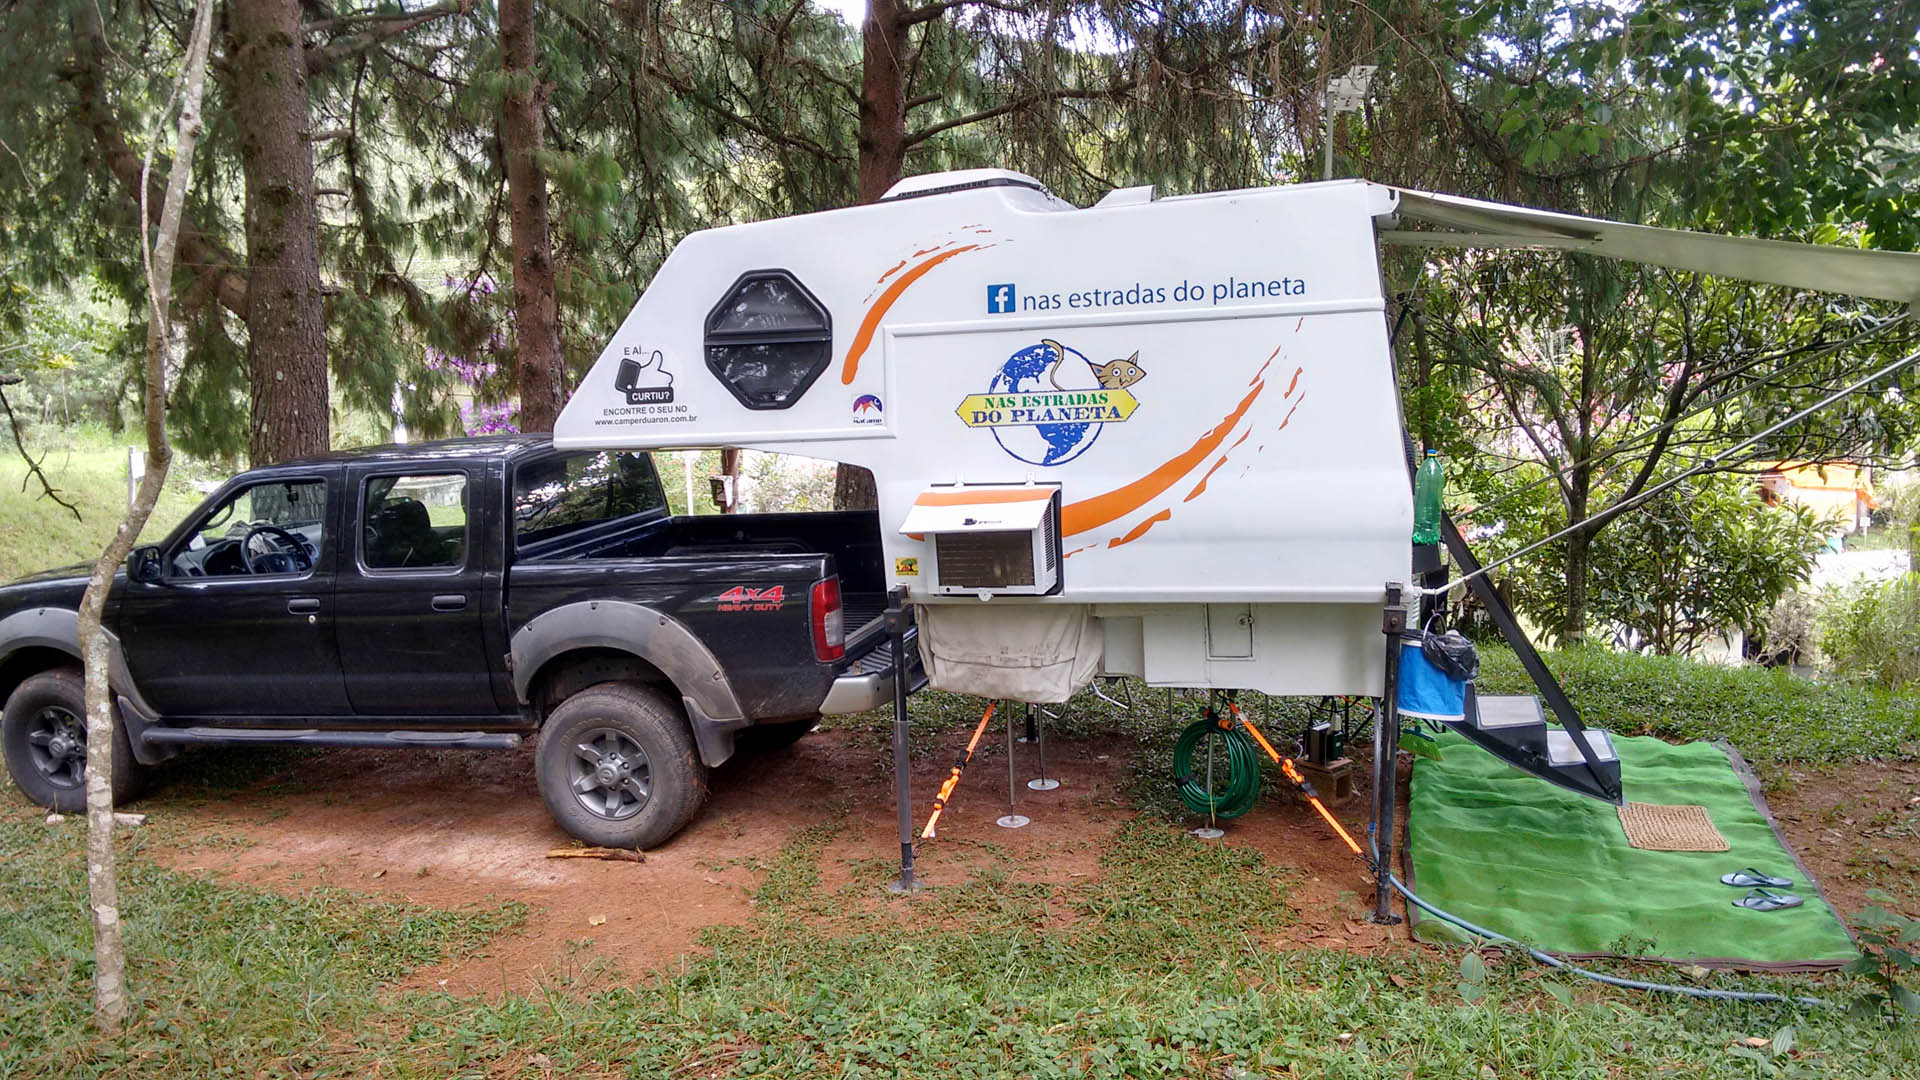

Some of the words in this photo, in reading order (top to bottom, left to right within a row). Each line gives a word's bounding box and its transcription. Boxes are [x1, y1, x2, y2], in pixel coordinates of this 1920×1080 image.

[1023, 294, 1061, 311] nas
[1068, 283, 1166, 308] estradas
[1173, 280, 1205, 302] do
[1213, 276, 1305, 304] planeta
[624, 347, 630, 355] E
[631, 391, 670, 401] CURTIU?
[984, 397, 1016, 409] NAS
[1022, 392, 1109, 408] ESTRADAS
[604, 407, 647, 416] ENCONTRE
[648, 406, 656, 414] O
[657, 406, 673, 414] SEU
[675, 405, 688, 413] NO
[972, 410, 1002, 424] DO
[1010, 406, 1123, 422] PLANETA
[595, 415, 697, 426] www.camperduaron.com.br
[719, 585, 784, 603] 4x4
[754, 603, 782, 611] DUTY
